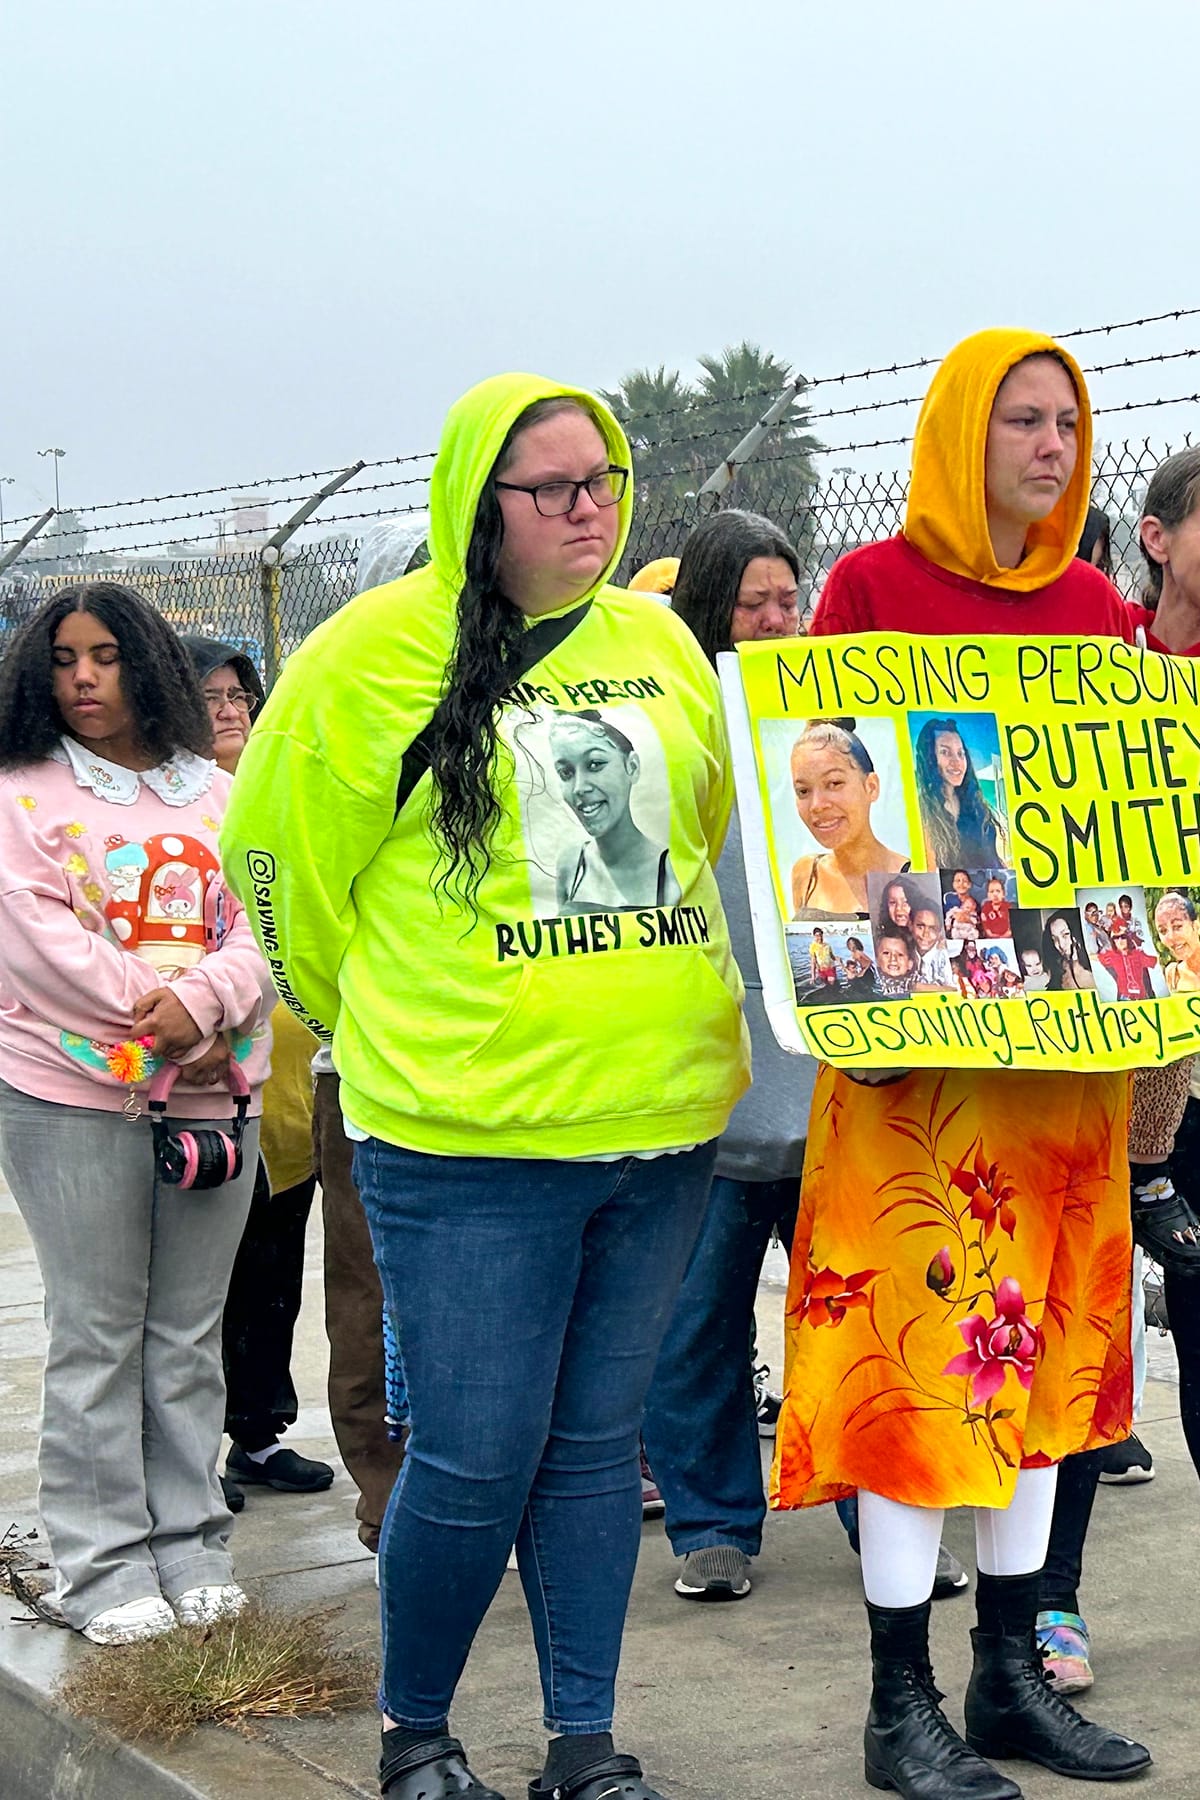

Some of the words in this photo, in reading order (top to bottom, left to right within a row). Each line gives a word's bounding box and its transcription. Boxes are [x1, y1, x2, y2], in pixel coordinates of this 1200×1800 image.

[561, 675, 666, 706] PERSON
[776, 644, 990, 712] MISSING
[1018, 642, 1199, 706] PERSON
[495, 914, 621, 962] RUTHEY
[636, 905, 709, 948] SMITH
